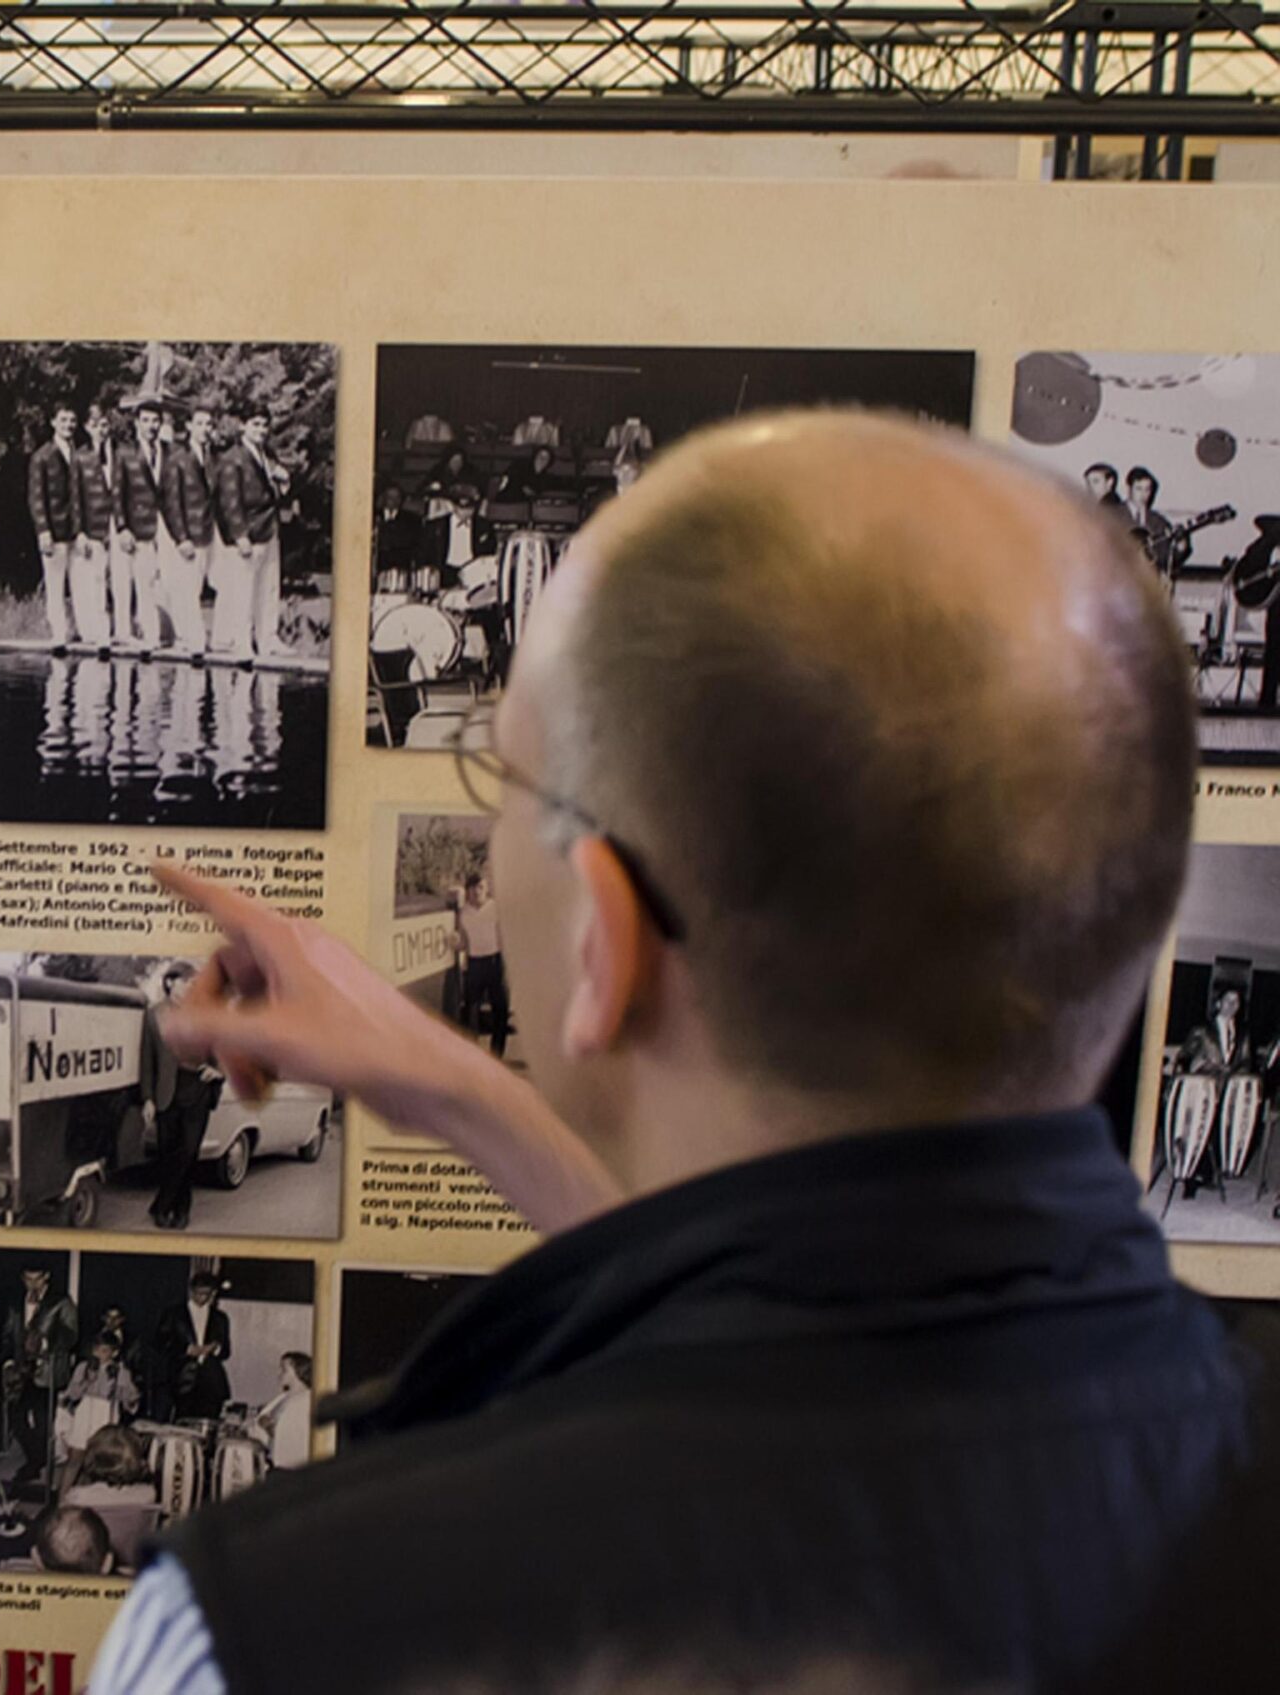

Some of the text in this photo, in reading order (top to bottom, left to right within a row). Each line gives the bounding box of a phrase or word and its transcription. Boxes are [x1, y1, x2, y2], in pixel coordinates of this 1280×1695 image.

[1207, 783, 1266, 798] Franco
[88, 842, 129, 856] 1962
[156, 844, 176, 859] La
[185, 844, 233, 861] prima
[243, 846, 324, 863] fotografia
[70, 861, 116, 874] Mario
[272, 866, 324, 882] Beppe
[57, 878, 109, 894] (piano
[114, 884, 123, 893] e
[260, 885, 324, 899] Gelmini
[43, 897, 106, 911] Antonio
[107, 899, 176, 915] Campari
[73, 916, 153, 935] (batteria)
[362, 1160, 410, 1174] Prima
[412, 1162, 428, 1175] di
[361, 1180, 441, 1194] strumenti
[360, 1198, 390, 1209] con
[392, 1200, 412, 1210] un
[415, 1200, 471, 1213] piccolo
[360, 1214, 371, 1226] il
[375, 1215, 403, 1230] sig.
[407, 1216, 493, 1231] Napoleone
[17, 1582, 31, 1594] la
[35, 1583, 100, 1599] stagione
